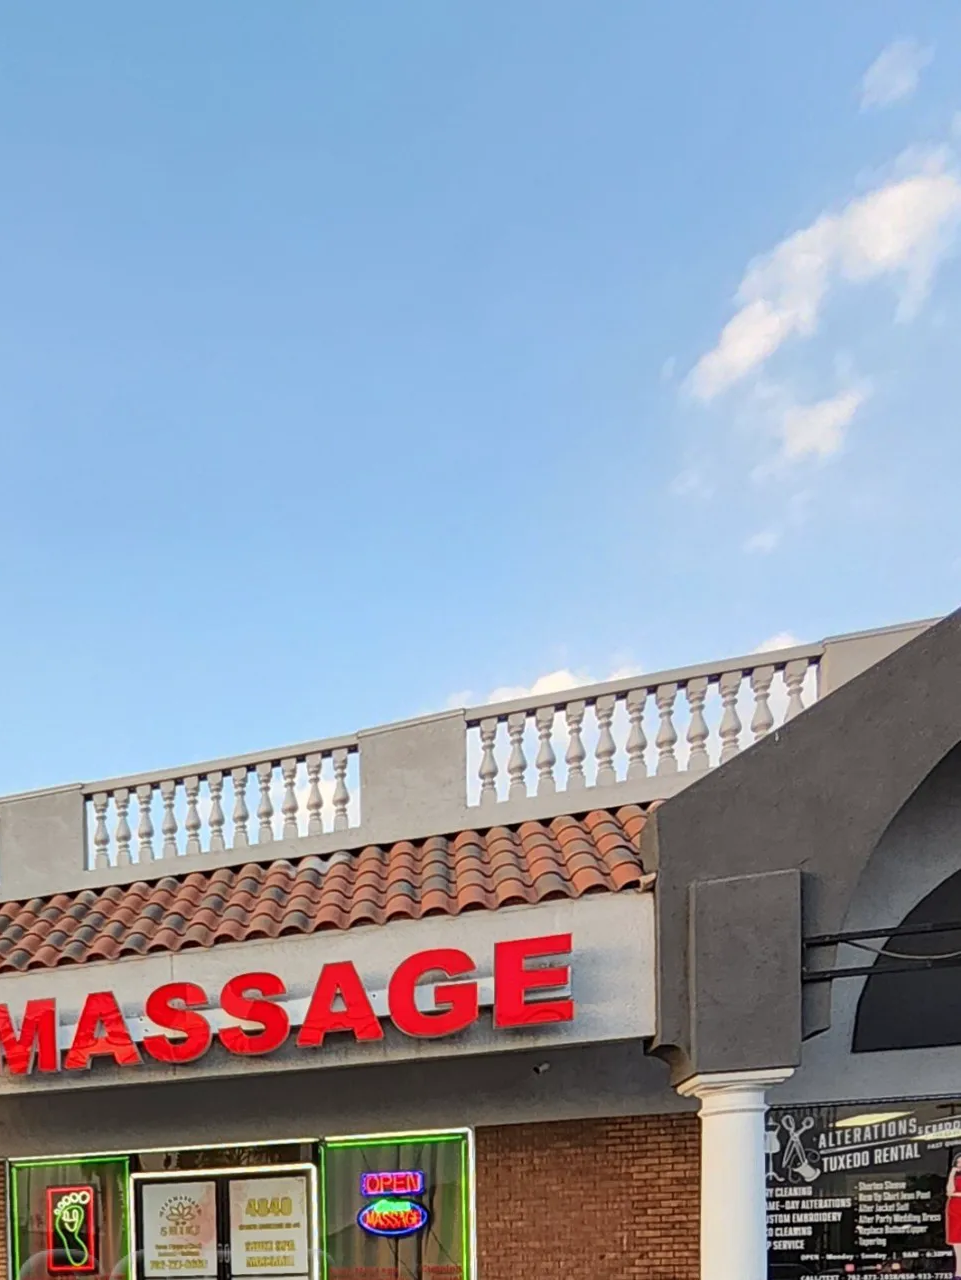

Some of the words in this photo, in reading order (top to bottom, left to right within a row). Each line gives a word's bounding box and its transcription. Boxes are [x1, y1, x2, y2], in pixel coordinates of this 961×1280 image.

[818, 1118, 918, 1149] ALTERATIONS
[822, 1151, 870, 1173] TUXEDO
[874, 1143, 921, 1164] RENTAL
[365, 1172, 419, 1193] OPEN
[775, 1186, 812, 1197] CLEANING
[801, 1198, 852, 1209] ALTERATIONS
[792, 1212, 842, 1223] EMBROIDERY
[775, 1226, 812, 1237] CLEANING
[773, 1240, 805, 1250] SERVICE
